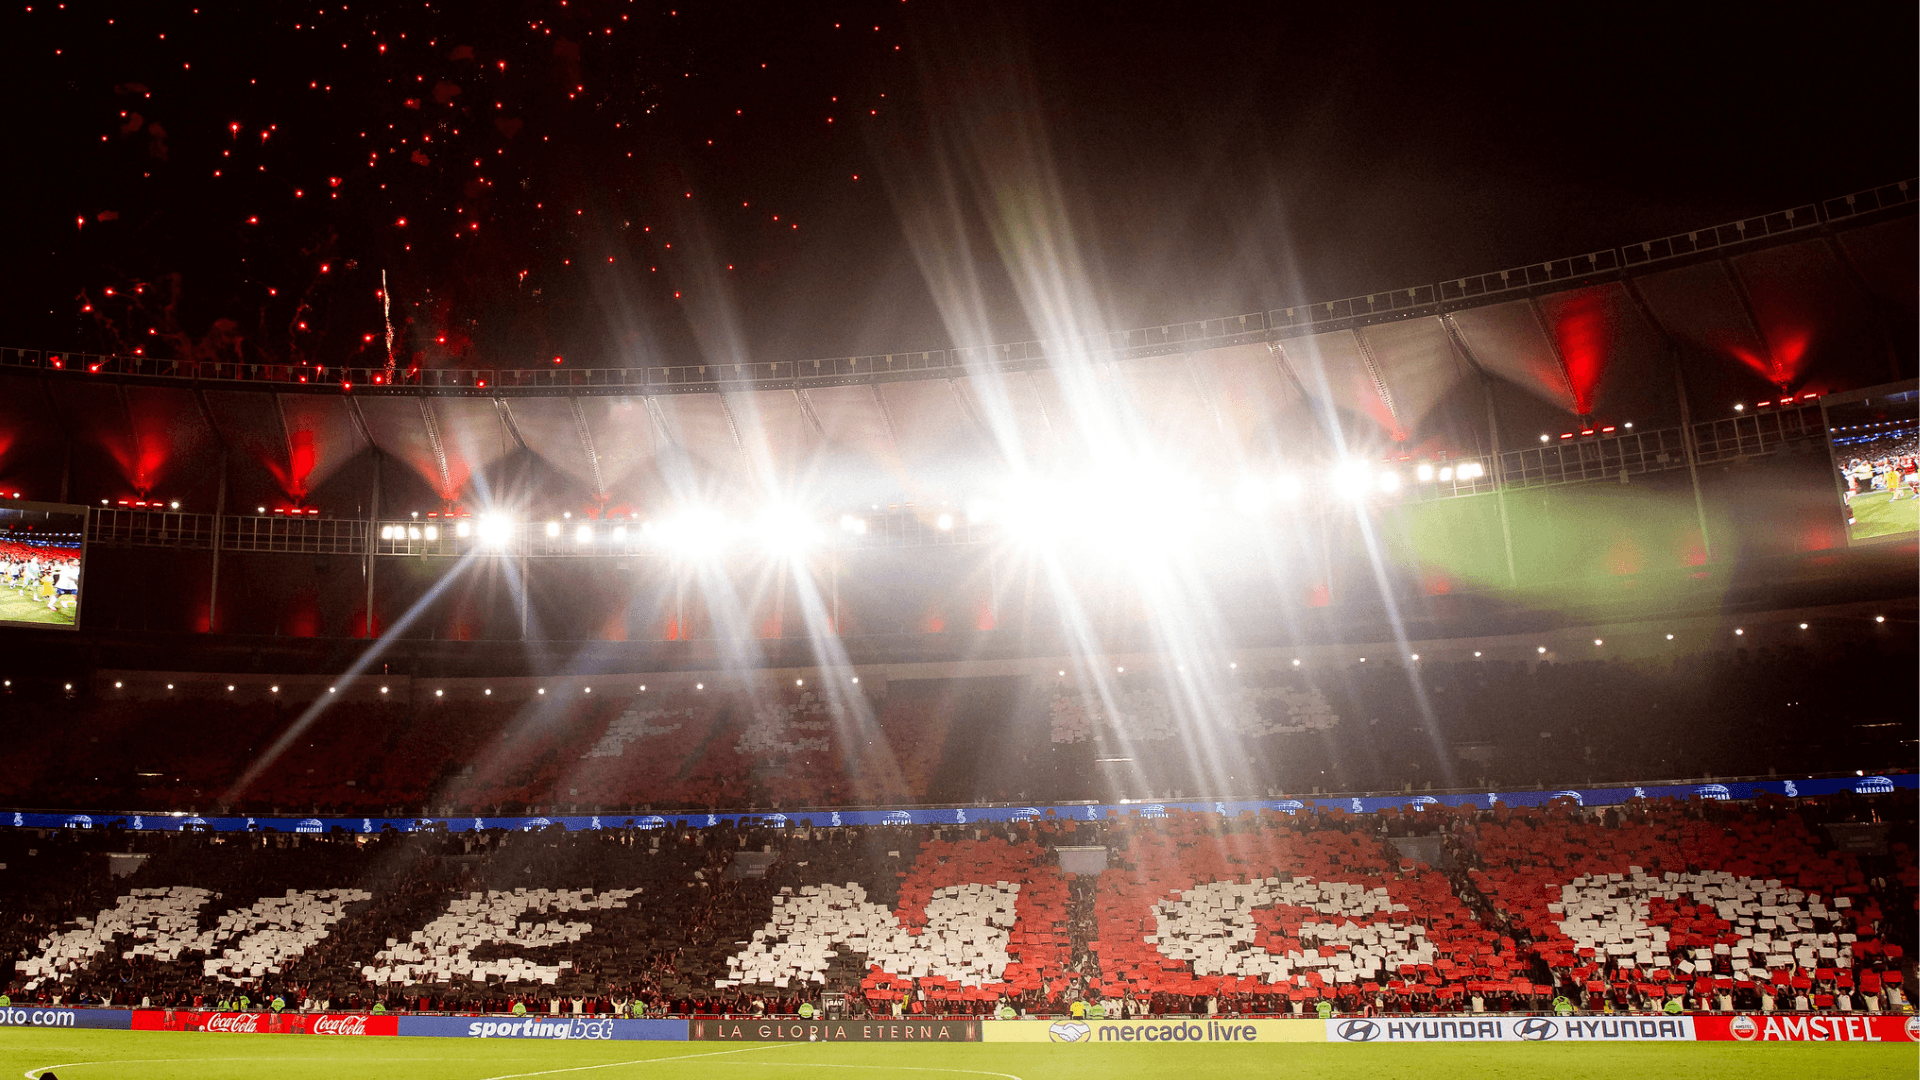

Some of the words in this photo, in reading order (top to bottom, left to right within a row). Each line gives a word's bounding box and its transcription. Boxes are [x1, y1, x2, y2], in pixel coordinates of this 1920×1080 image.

[207, 1012, 260, 1033] Coca-Cola
[313, 1013, 366, 1036] Coca-Cola
[468, 1018, 614, 1040] sportingbet
[718, 1025, 742, 1038] LA
[758, 1025, 847, 1039] GLORIA
[863, 1025, 951, 1039] ETERNA
[1098, 1021, 1203, 1041] mercado
[1208, 1021, 1257, 1042] livre
[1388, 1021, 1502, 1039] HYUNDAI
[1566, 1020, 1685, 1038] HYUNDAI
[1763, 1016, 1882, 1041] AMSTEL
